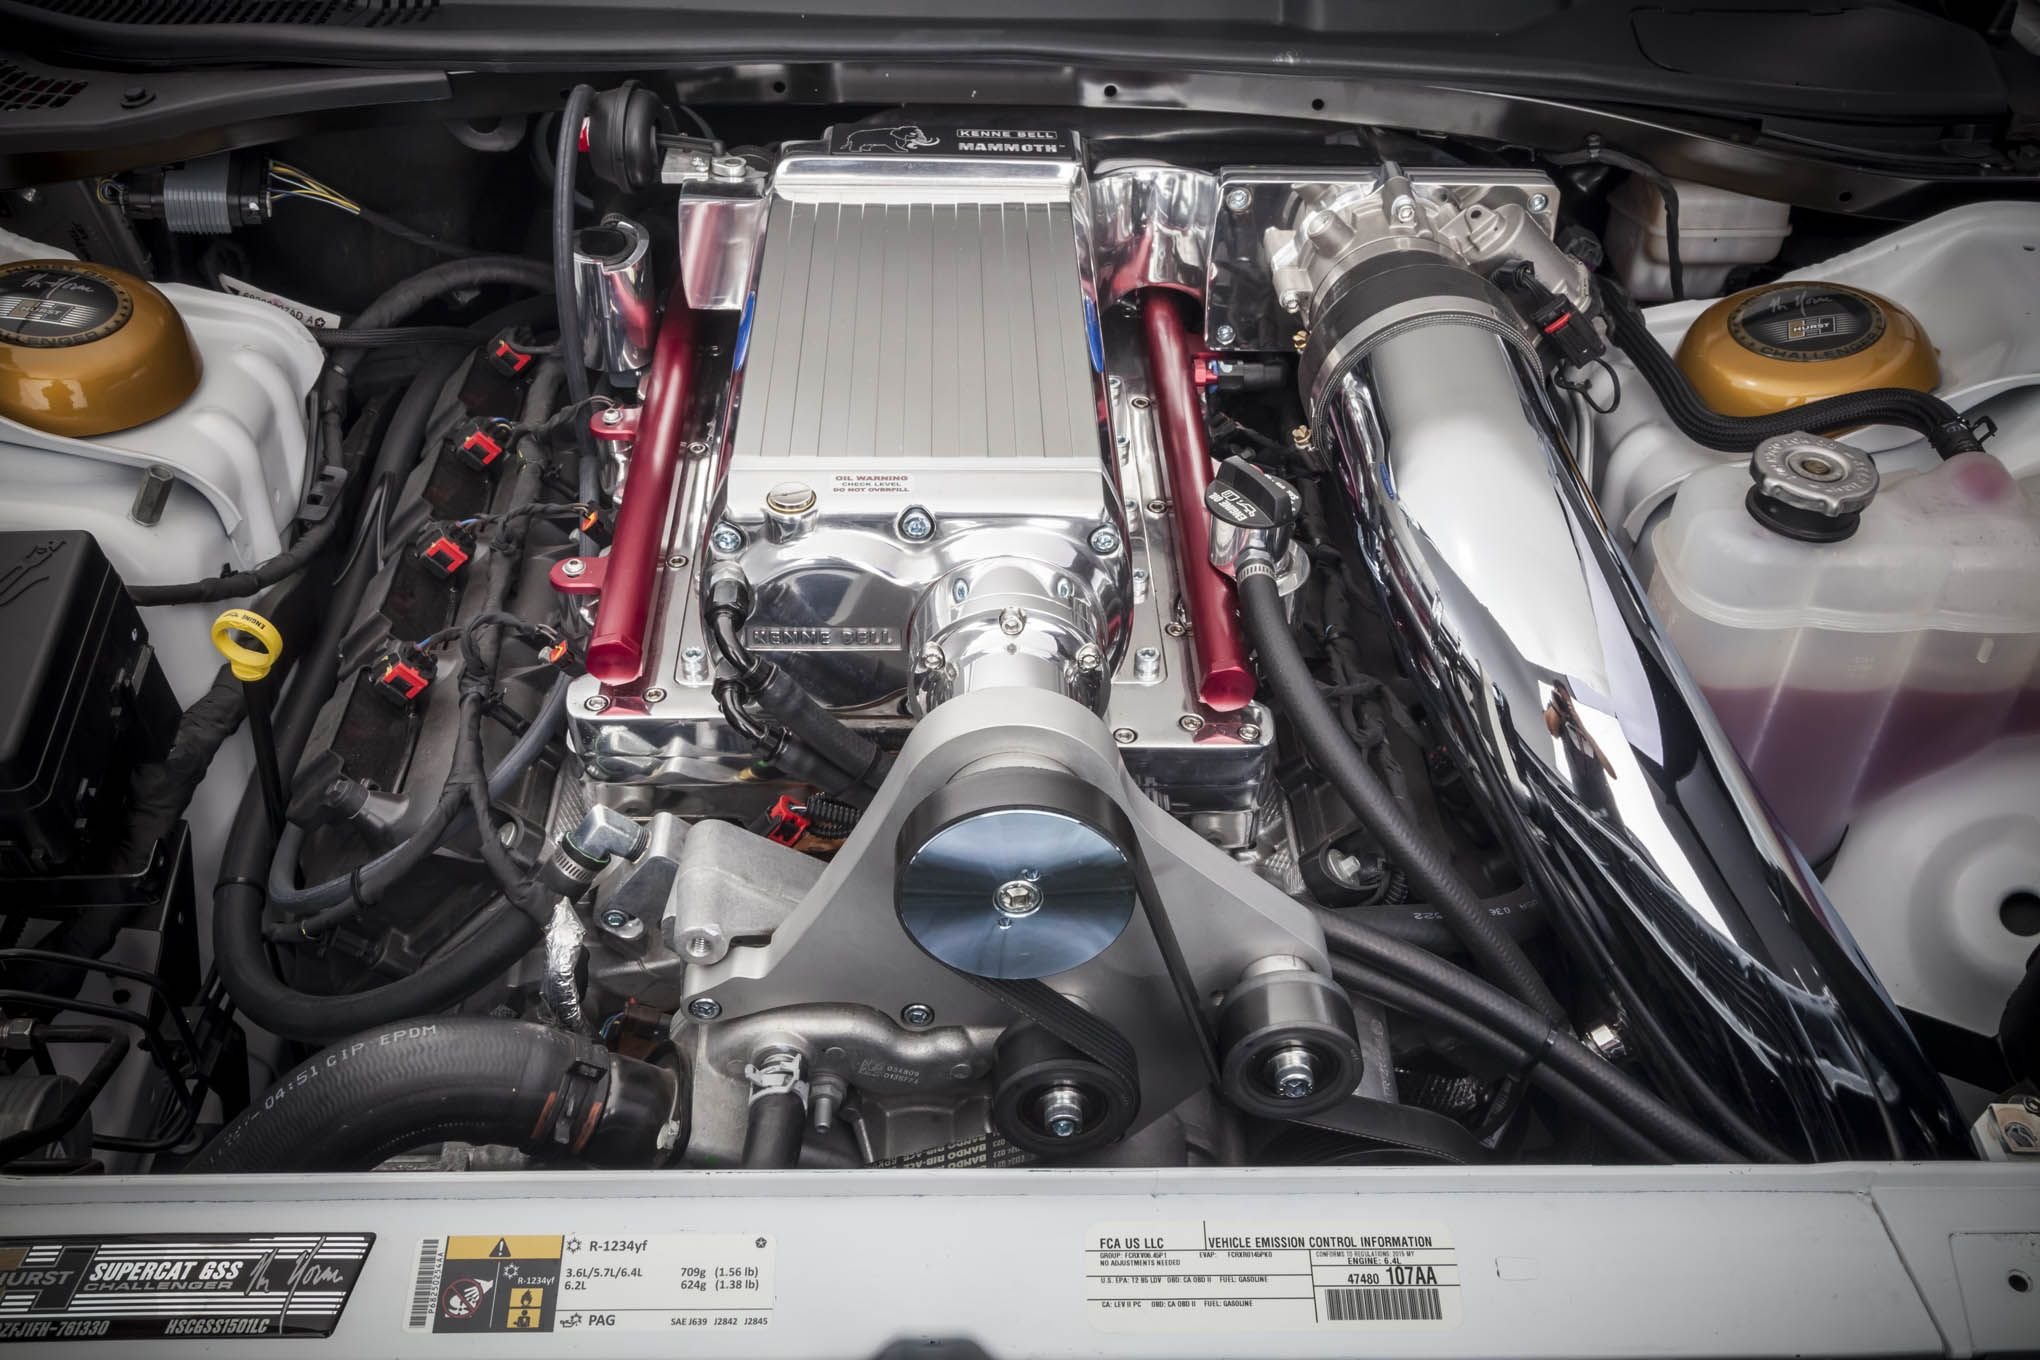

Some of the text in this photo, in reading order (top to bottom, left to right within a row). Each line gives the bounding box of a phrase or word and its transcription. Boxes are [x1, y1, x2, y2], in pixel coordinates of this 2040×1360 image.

[960, 130, 1054, 139] KENNE BELL
[753, 628, 832, 645] KENNE
[264, 1024, 437, 1111] 04:51 CIP EPDM
[947, 1143, 987, 1160] BANDO
[589, 1240, 648, 1254] R-1234yf
[1100, 1237, 1164, 1249] FCA US LLC
[1208, 1236, 1432, 1248] VEHICLE EMISSION CONTROL INFORMATION
[1348, 1257, 1402, 1265] ENGINE: 6.4L
[89, 1261, 245, 1282] SUPERCAT GSS
[565, 1266, 759, 1279] 3.6L/5.7L/6.4L 709g (1.56 lb)
[1348, 1266, 1438, 1285] 47480 107AA
[83, 1281, 233, 1292] CHALLENGER
[517, 1276, 555, 1286] R-1234yf
[564, 1279, 760, 1292] 6.2L 624g (1.38 lb)
[588, 1314, 769, 1327] PAG SAE J639 J2842 J2845
